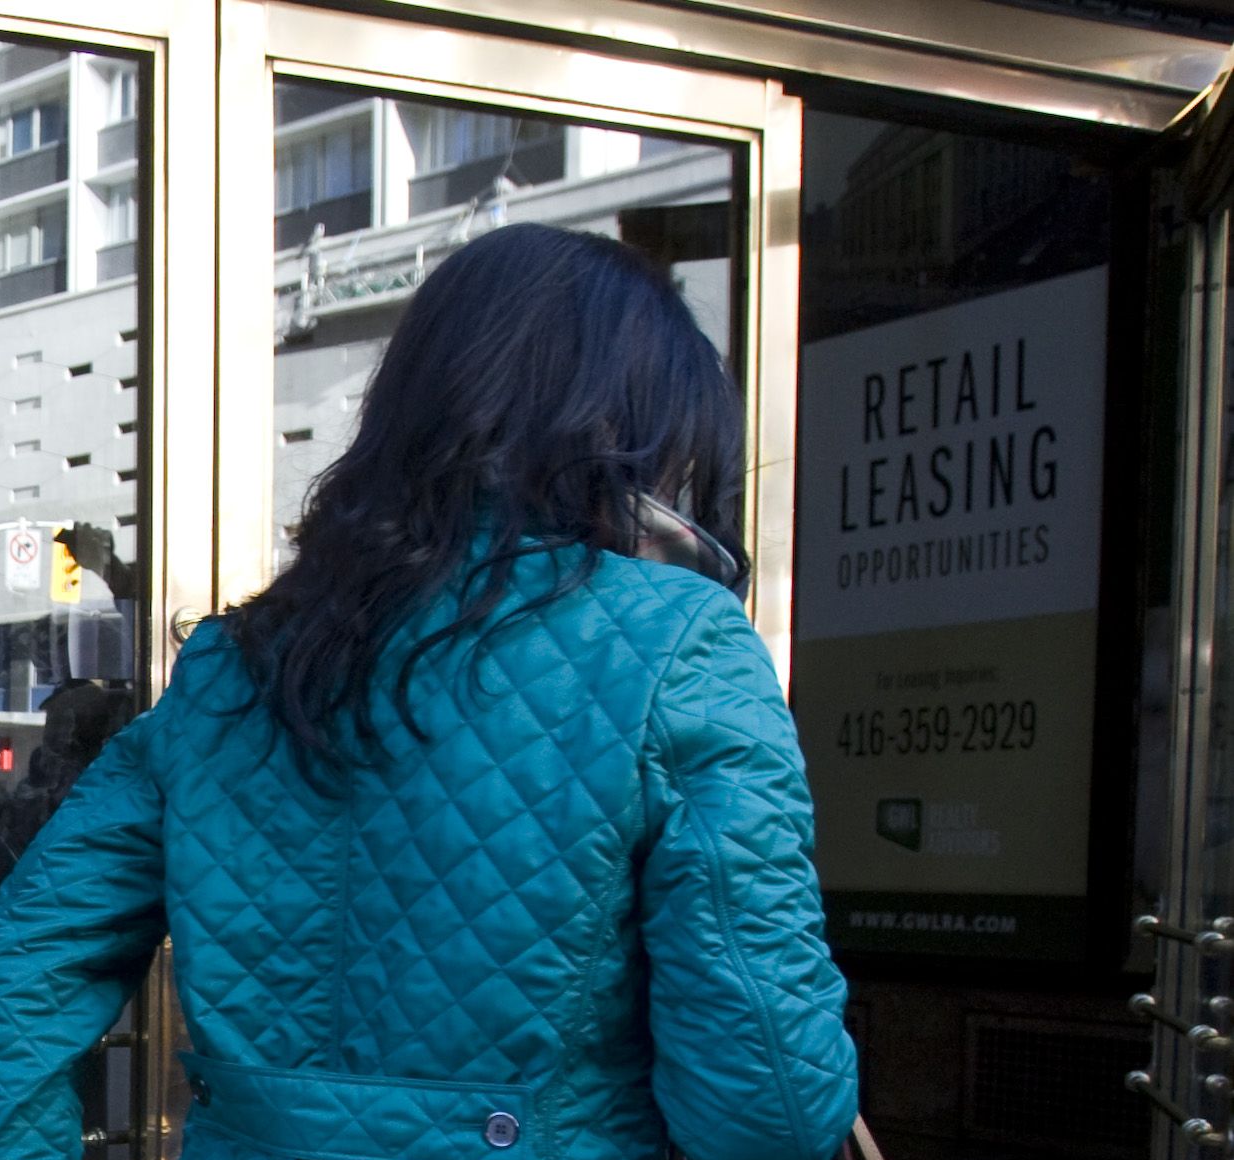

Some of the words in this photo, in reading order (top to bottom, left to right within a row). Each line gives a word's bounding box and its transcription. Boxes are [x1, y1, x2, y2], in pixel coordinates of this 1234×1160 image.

[863, 337, 1037, 445] RETAIL
[839, 425, 1058, 534] LEASING
[837, 523, 1050, 591] OPPORTUNITIES
[837, 700, 1037, 757] 416-359-2929
